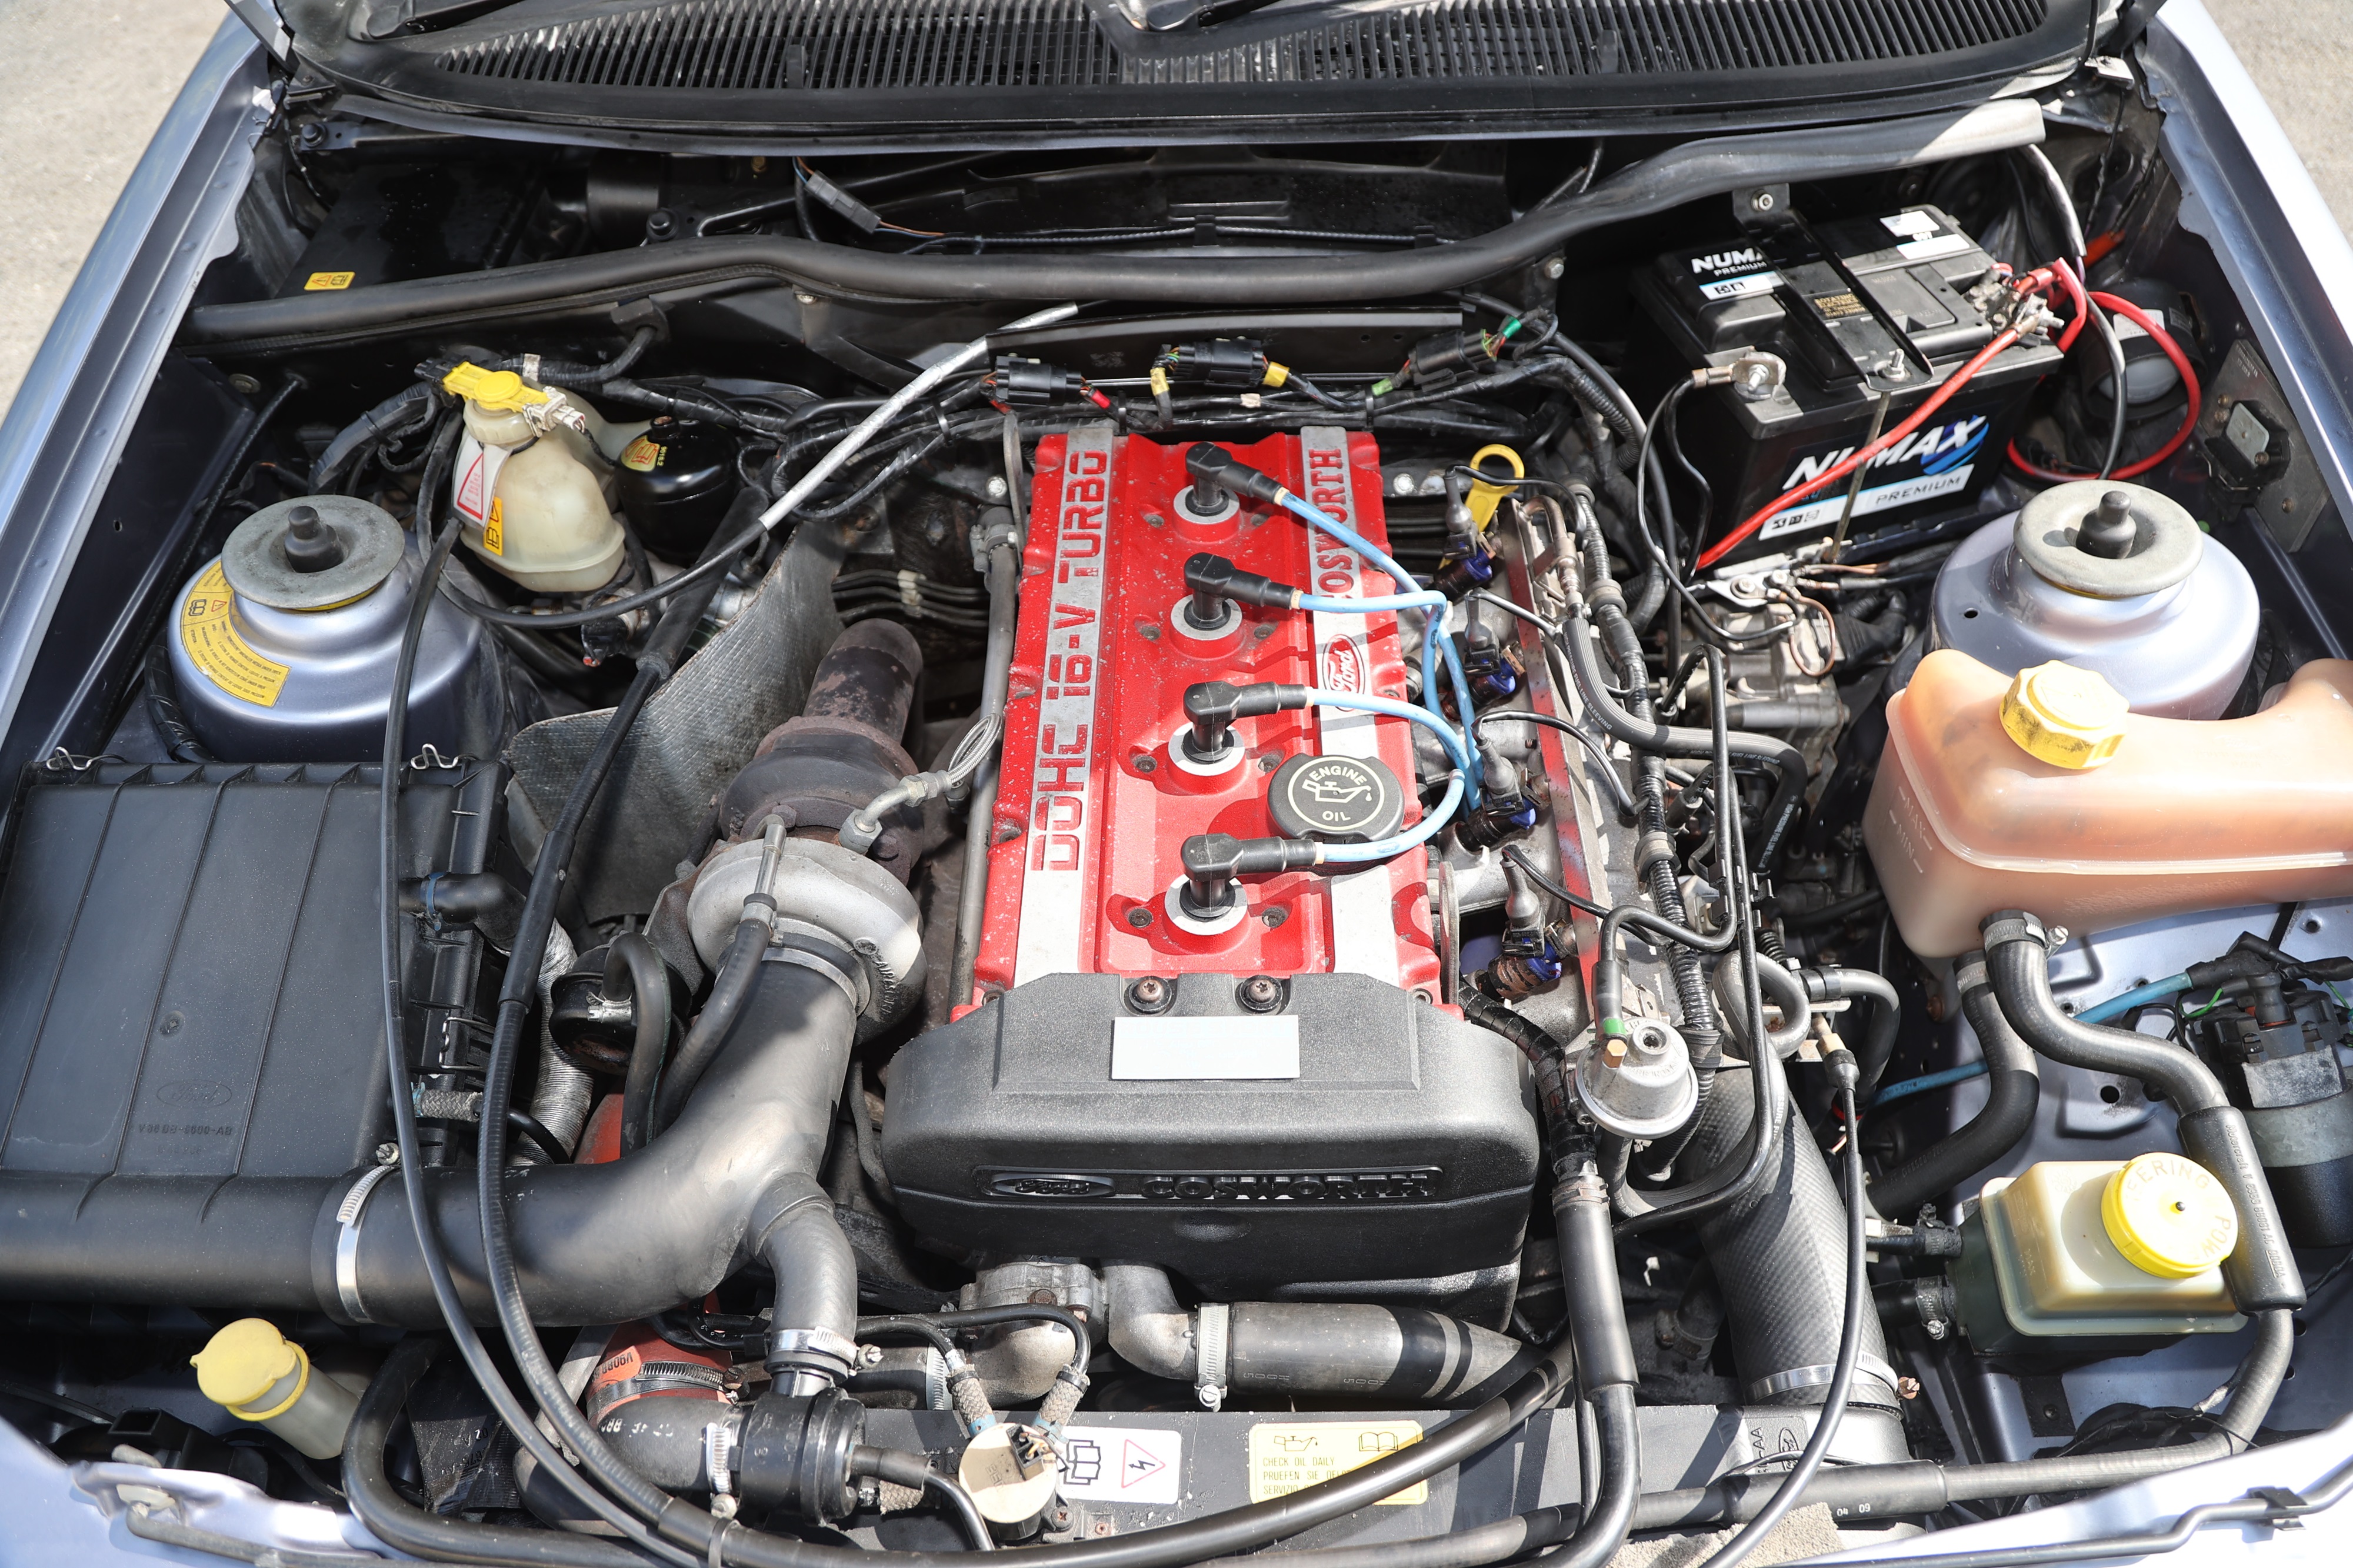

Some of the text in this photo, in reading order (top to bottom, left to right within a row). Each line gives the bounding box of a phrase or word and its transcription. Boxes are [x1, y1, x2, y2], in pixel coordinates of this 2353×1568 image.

[1691, 248, 1763, 274] NUM
[1714, 261, 1767, 276] PREMIUM
[1875, 476, 1961, 504] PREMIUM
[1056, 450, 1107, 585] TURBO
[1572, 672, 1581, 688] FUEL
[1579, 688, 1589, 703] LINE
[1587, 702, 1612, 730] SLEEVING
[1309, 765, 1368, 786] ENGINE
[1029, 724, 1089, 871] DOHC
[1322, 810, 1351, 822] OIL
[1904, 797, 1922, 839] MAX
[1897, 824, 1914, 859] MIN
[1014, 1173, 1438, 1200] Ford COSWORTH
[1263, 1457, 1335, 1467] CHECK OIL DAILY
[1264, 1471, 1299, 1480] PRUEFEN
[1307, 1471, 1319, 1480] SIE
[1836, 1508, 1849, 1517] 04
[1859, 1502, 1871, 1513] 09
